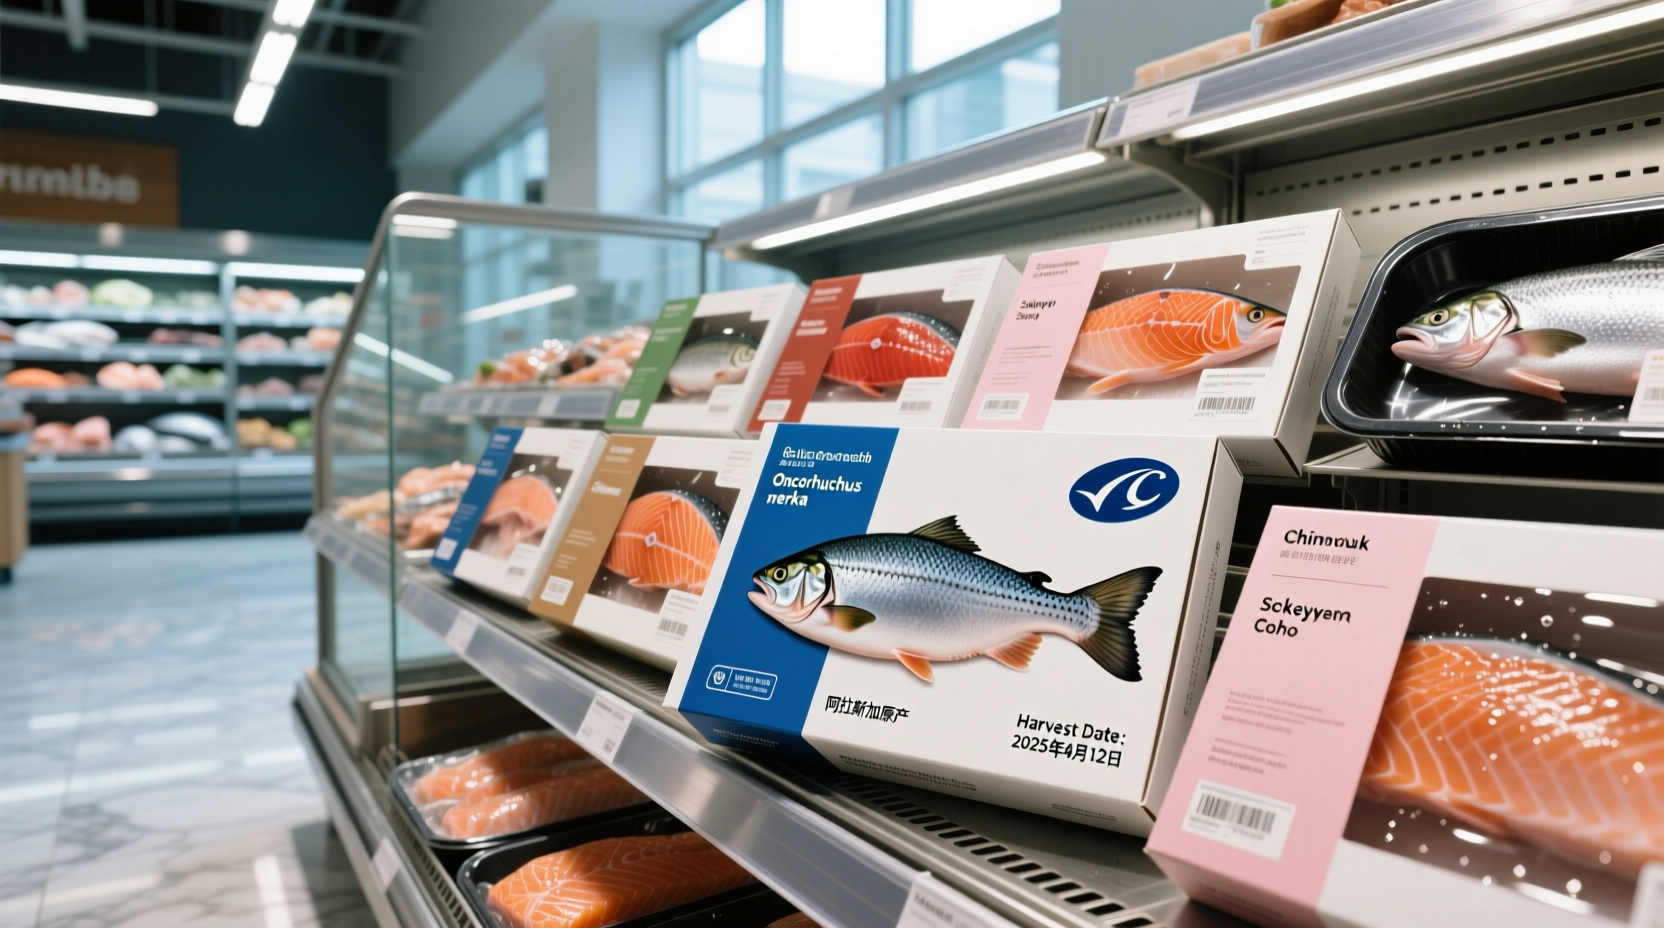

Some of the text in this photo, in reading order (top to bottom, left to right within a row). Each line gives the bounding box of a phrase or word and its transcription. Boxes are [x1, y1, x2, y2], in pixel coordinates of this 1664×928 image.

[772, 472, 863, 493] Oncorhuchus
[766, 490, 808, 506] nerka
[1254, 618, 1298, 637] Coho
[1016, 713, 1126, 745] Harvest Date:
